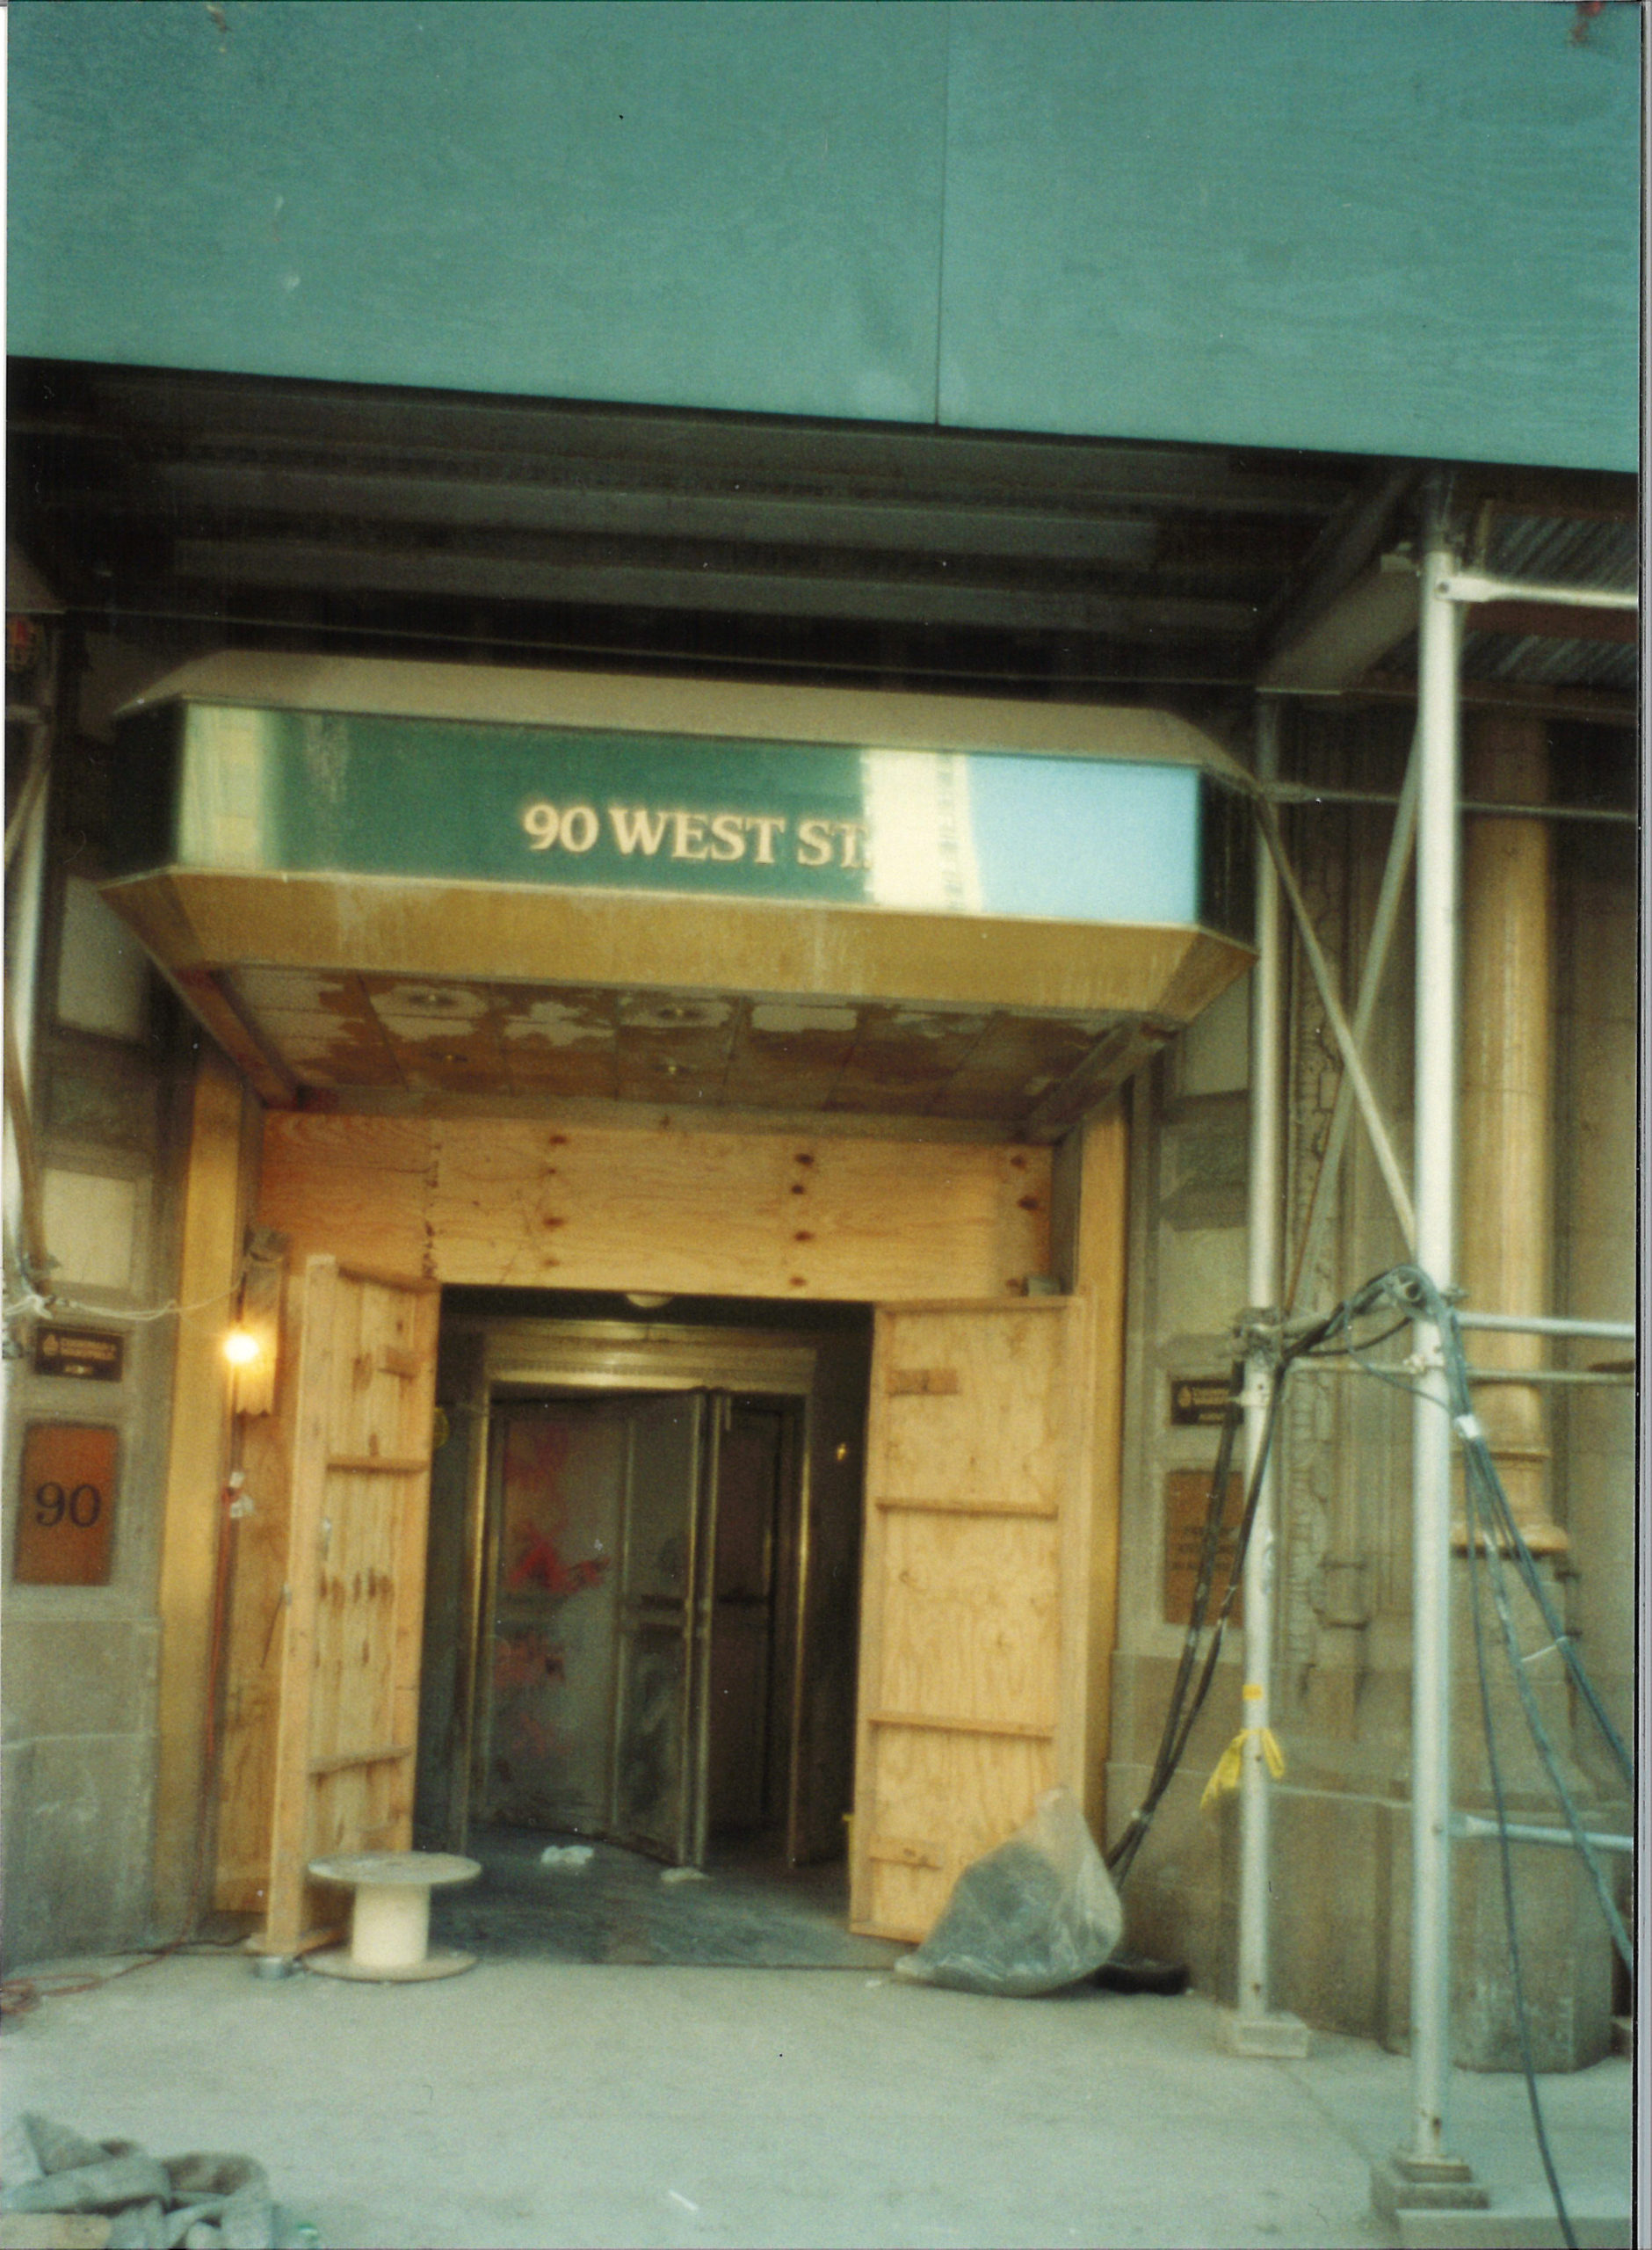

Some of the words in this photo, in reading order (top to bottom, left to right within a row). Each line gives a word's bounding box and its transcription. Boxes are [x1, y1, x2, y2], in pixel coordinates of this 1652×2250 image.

[523, 803, 599, 853] 90
[609, 808, 786, 865] WEST
[35, 1481, 101, 1528] 90
